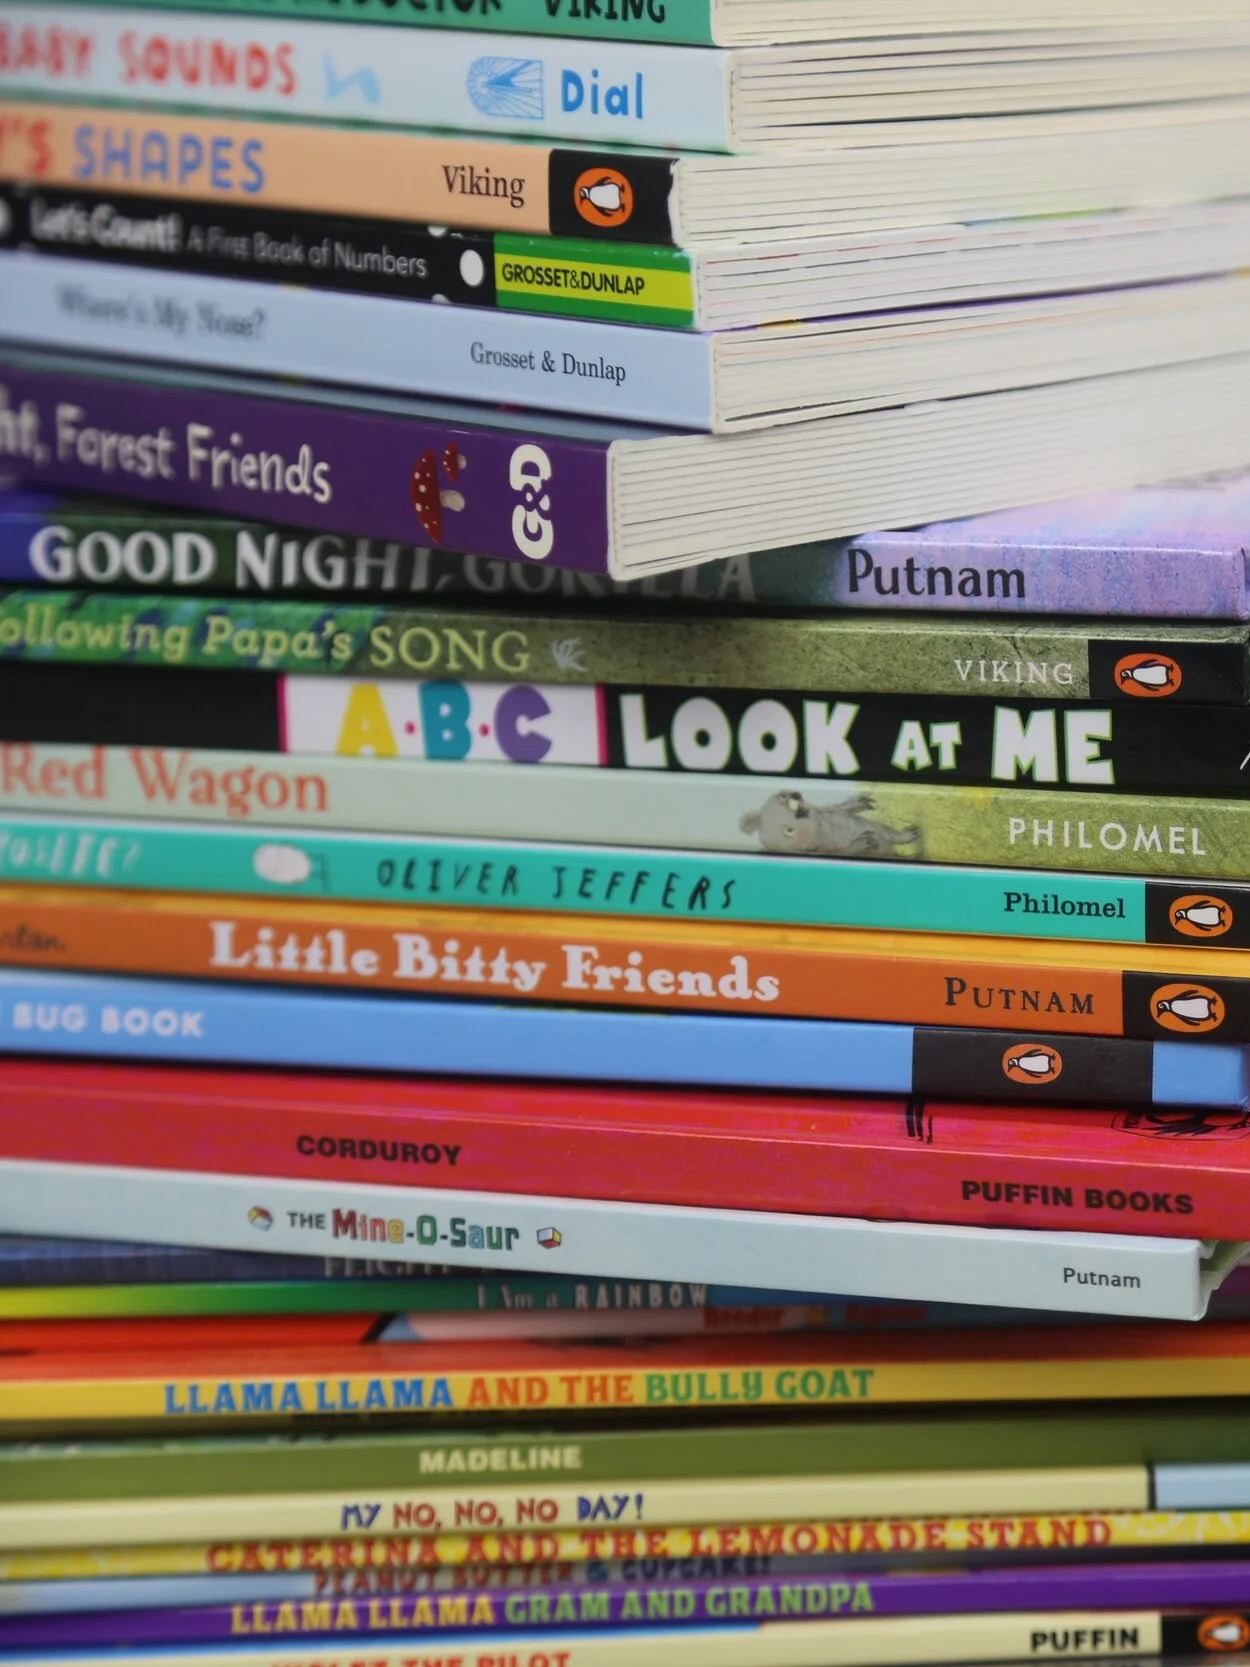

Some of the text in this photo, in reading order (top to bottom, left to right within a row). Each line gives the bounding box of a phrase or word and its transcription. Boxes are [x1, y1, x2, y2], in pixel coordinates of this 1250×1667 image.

[117, 30, 298, 95] SOUNDS
[561, 69, 643, 119] Dial
[74, 125, 265, 193] SHAPES
[442, 165, 525, 208] Viking
[91, 203, 182, 253] Count!
[187, 225, 428, 278] A First Book of Numbers
[502, 262, 645, 295] GROSSET&DUNLAP
[152, 295, 189, 340] My
[471, 342, 626, 386] Grosset & Dunlap
[56, 403, 175, 480] Forest
[187, 423, 332, 503] Friends
[29, 525, 216, 584] GOOD
[847, 548, 1026, 598] Putnam
[202, 615, 353, 667] Papa's
[370, 627, 531, 673] SONG
[954, 659, 1074, 685] VIKING
[620, 693, 1115, 785] LOOK AT ME
[0, 742, 330, 818] Red Wagon
[1008, 817, 1207, 855] PHILOMEL
[377, 858, 737, 911] OLIVER JEFFERS
[1004, 892, 1126, 919] Philomel
[210, 921, 780, 1002] Little Bitty Friends
[944, 976, 1095, 1016] PUTNAM
[13, 1001, 204, 1037] BUG BOOK
[297, 1135, 462, 1166] CORDUROY
[961, 1180, 1195, 1215] PUFFIN BOOKS
[287, 1208, 520, 1251] THE Mine-O-Saur
[575, 1283, 709, 1310] RAINBOW
[1063, 1267, 1141, 1290] Putnam
[164, 1368, 874, 1414] LLAMA LLAMA AND THE BULLY GOAT
[419, 1445, 582, 1474] MADELINE
[340, 1494, 643, 1531] MY NO, NO, NO DAY!
[206, 1518, 1112, 1573] CATERINA AND THE LEMONADE STAND
[232, 1582, 875, 1634] LLAMA LLAMA GRAM AND GRANDPA
[1031, 1628, 1139, 1652] PUFFIN
